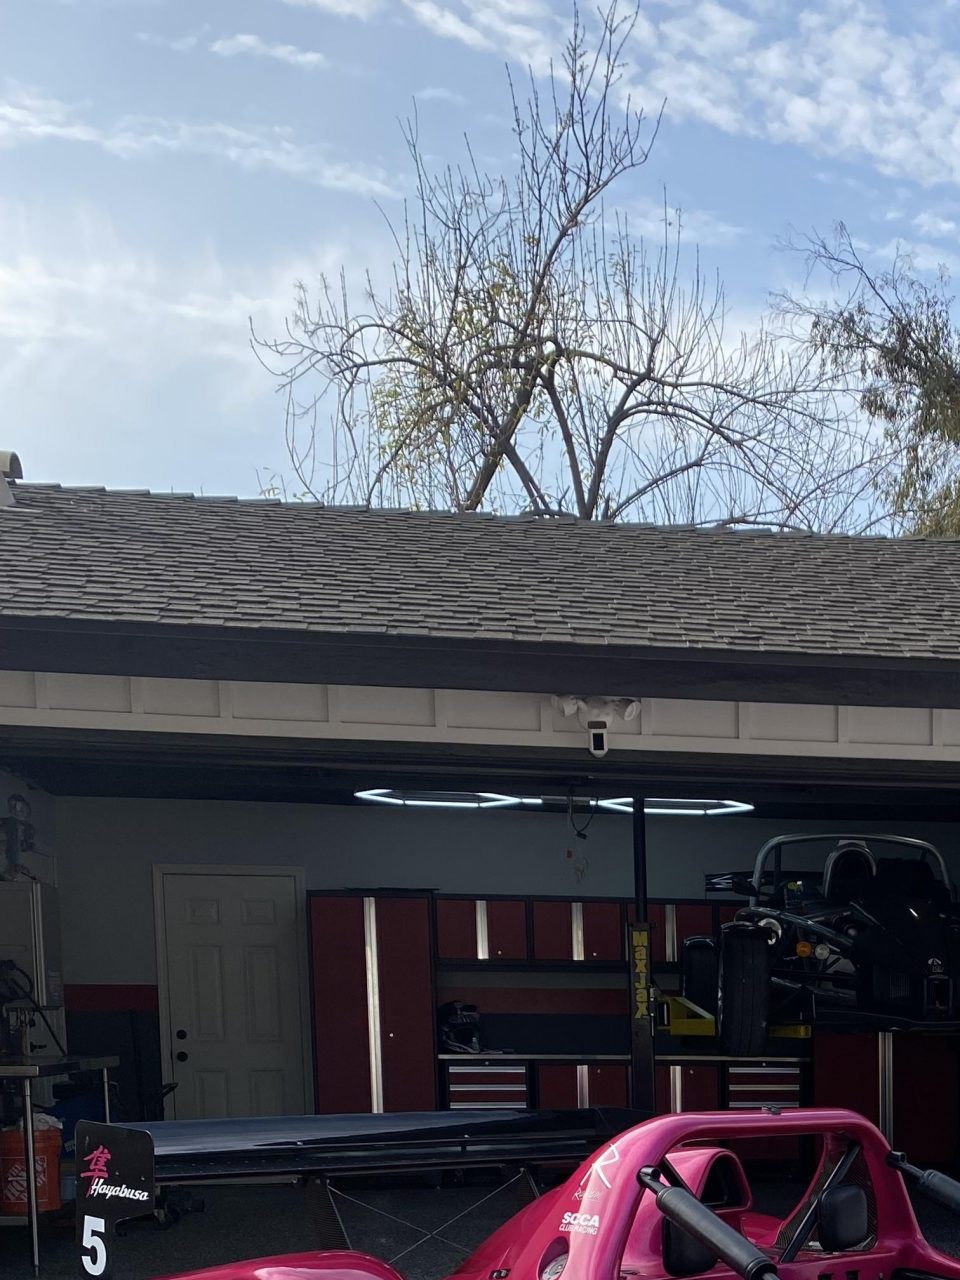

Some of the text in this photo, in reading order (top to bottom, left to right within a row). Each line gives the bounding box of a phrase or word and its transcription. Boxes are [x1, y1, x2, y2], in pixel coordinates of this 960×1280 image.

[80, 1144, 112, 1198] 隼
[90, 1178, 150, 1201] Hayabusa
[561, 1211, 600, 1228] SCCA
[81, 1214, 107, 1276] 5
